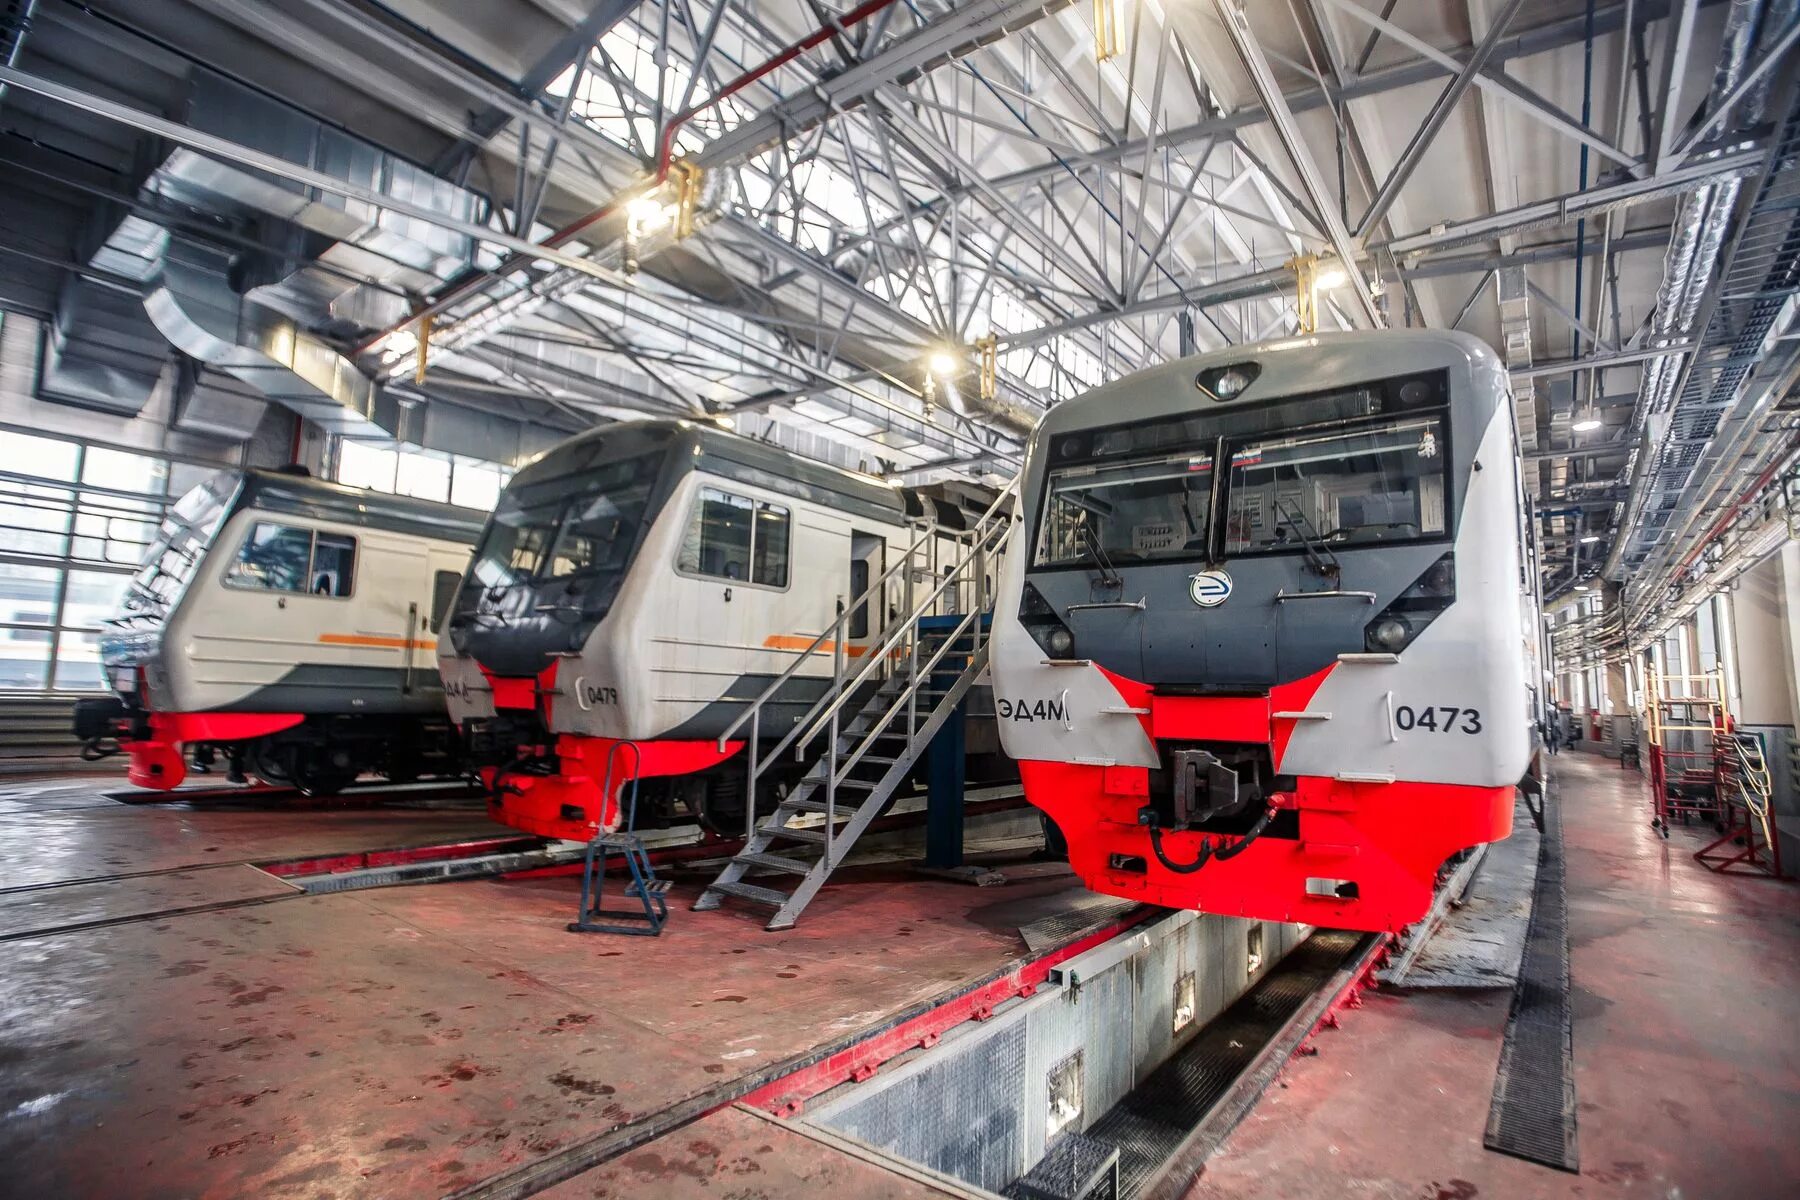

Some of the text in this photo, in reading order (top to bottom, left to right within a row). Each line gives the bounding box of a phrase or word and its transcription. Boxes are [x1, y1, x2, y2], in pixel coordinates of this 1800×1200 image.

[588, 687, 617, 704] 0479
[997, 698, 1069, 722] ЭД4М
[1396, 705, 1482, 734] 0473
